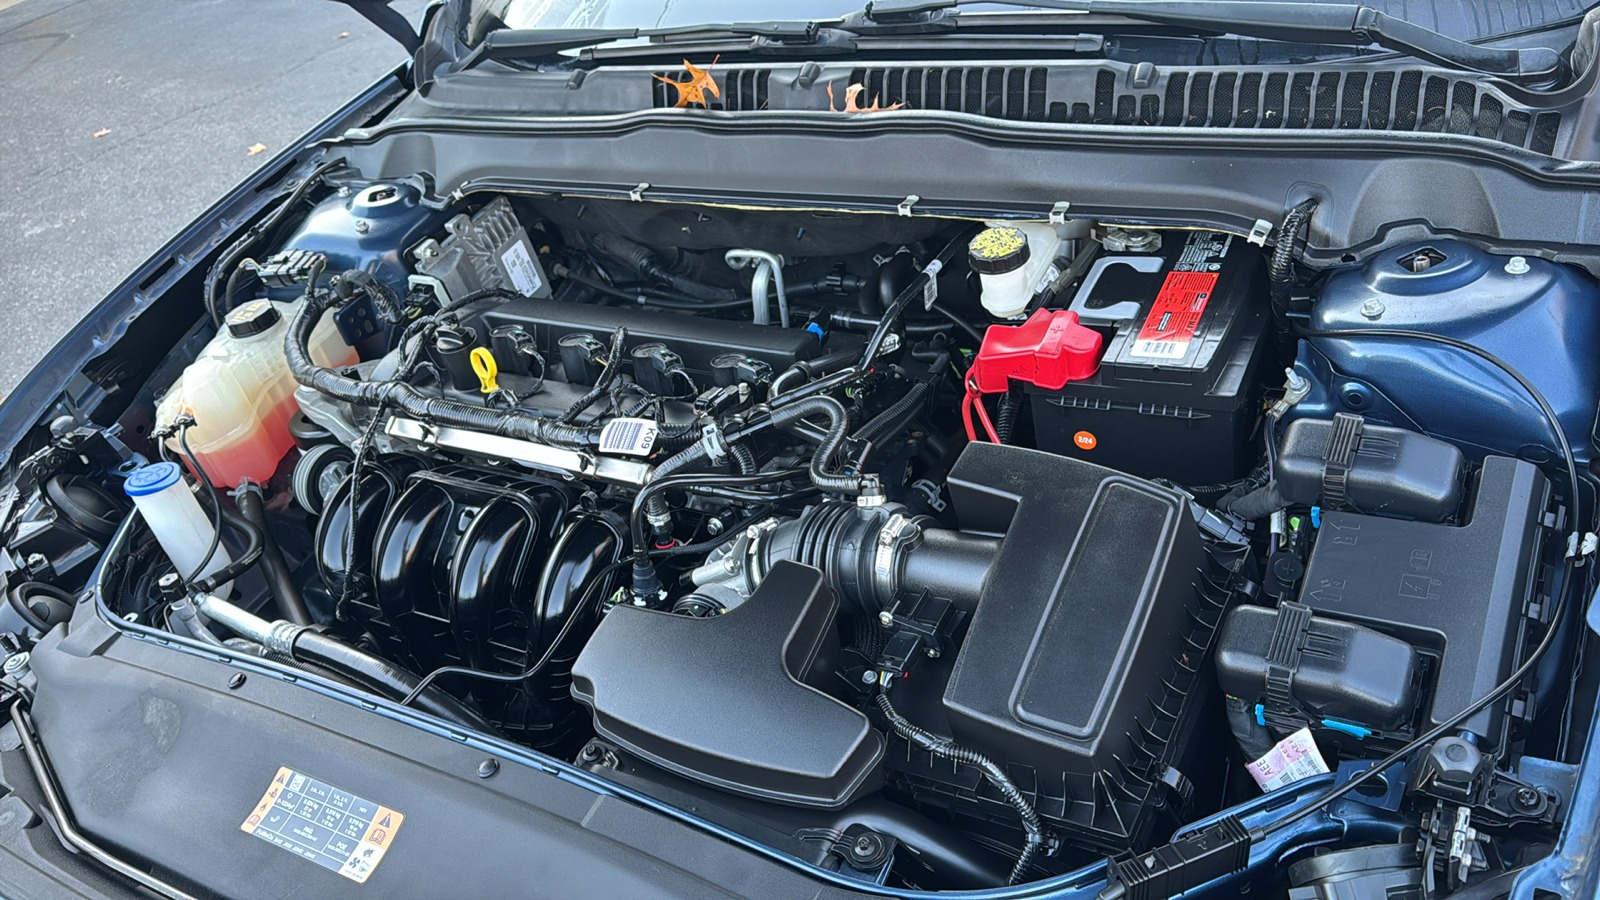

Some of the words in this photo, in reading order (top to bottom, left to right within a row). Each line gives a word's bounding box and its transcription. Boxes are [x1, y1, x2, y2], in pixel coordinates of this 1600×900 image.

[641, 428, 656, 449] K09
[1078, 436, 1092, 444] 2/24
[1256, 759, 1274, 776] AEE
